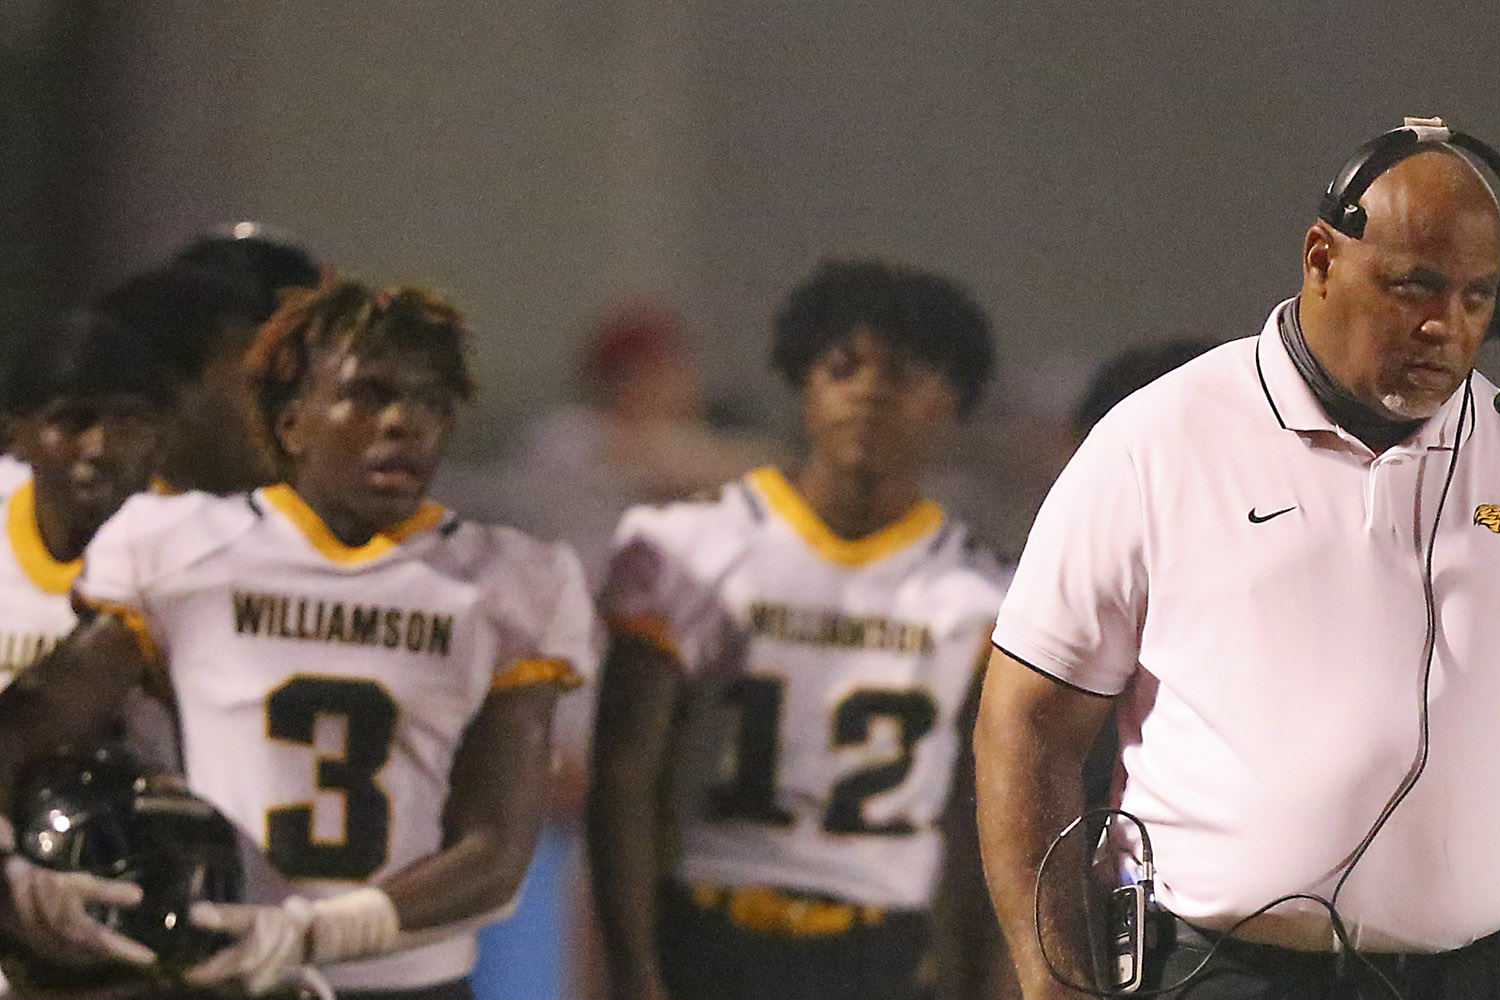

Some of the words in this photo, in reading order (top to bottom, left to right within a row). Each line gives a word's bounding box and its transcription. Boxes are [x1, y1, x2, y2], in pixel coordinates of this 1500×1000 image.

[232, 591, 455, 656] WILLIAMSON
[265, 673, 401, 883] 3
[697, 669, 943, 836] 12
